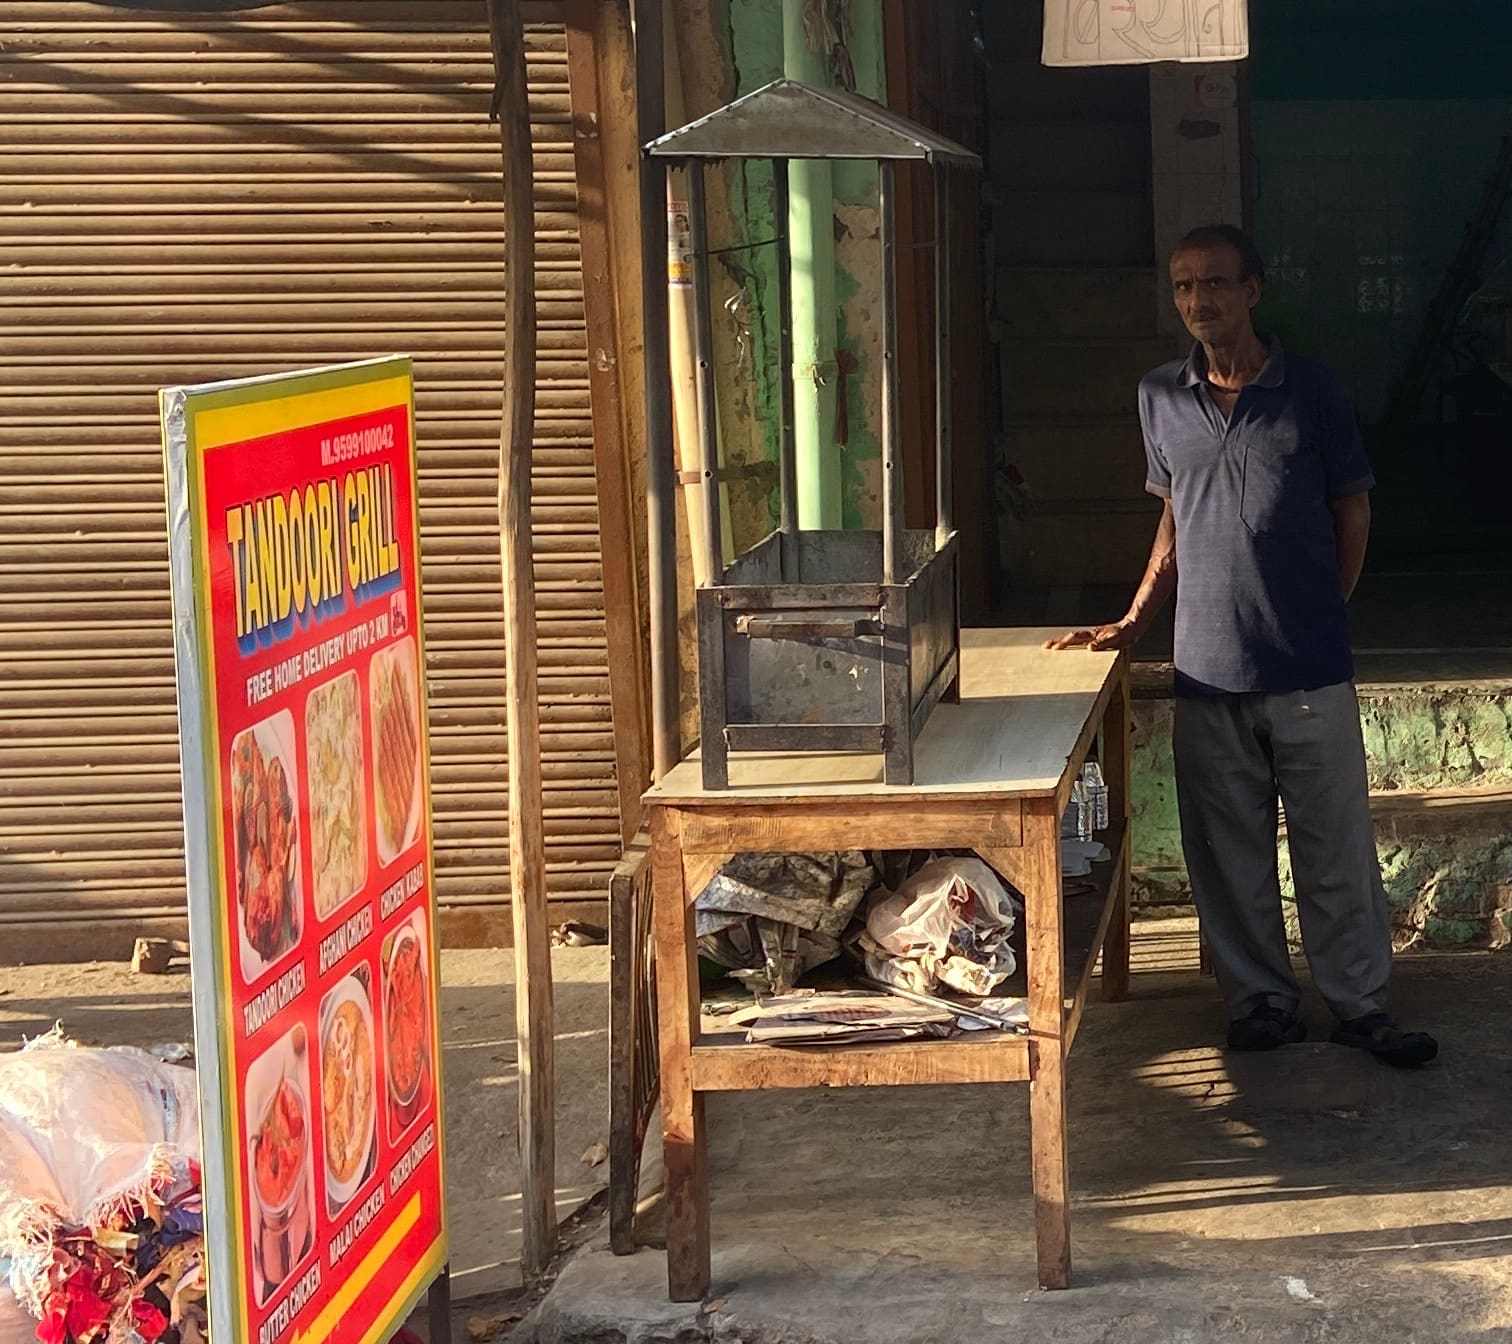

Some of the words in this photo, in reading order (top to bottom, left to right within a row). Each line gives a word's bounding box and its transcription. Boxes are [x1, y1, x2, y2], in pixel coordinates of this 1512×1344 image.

[320, 423, 394, 467] M.9599100042
[224, 478, 343, 642] TANDOORI
[344, 462, 400, 594] GRILL
[246, 672, 273, 707] FREE
[274, 654, 302, 694] HOME
[303, 635, 345, 680] DELIVERY
[347, 624, 369, 655] UPTO
[369, 621, 376, 648] 2
[347, 903, 373, 952] CHICKEN
[243, 982, 278, 1039] TANDOORI
[278, 958, 306, 1010] CHICKEN
[329, 1219, 352, 1268] MALAI
[353, 1182, 386, 1237] CHICKEN
[289, 1258, 321, 1320] CHICKEN
